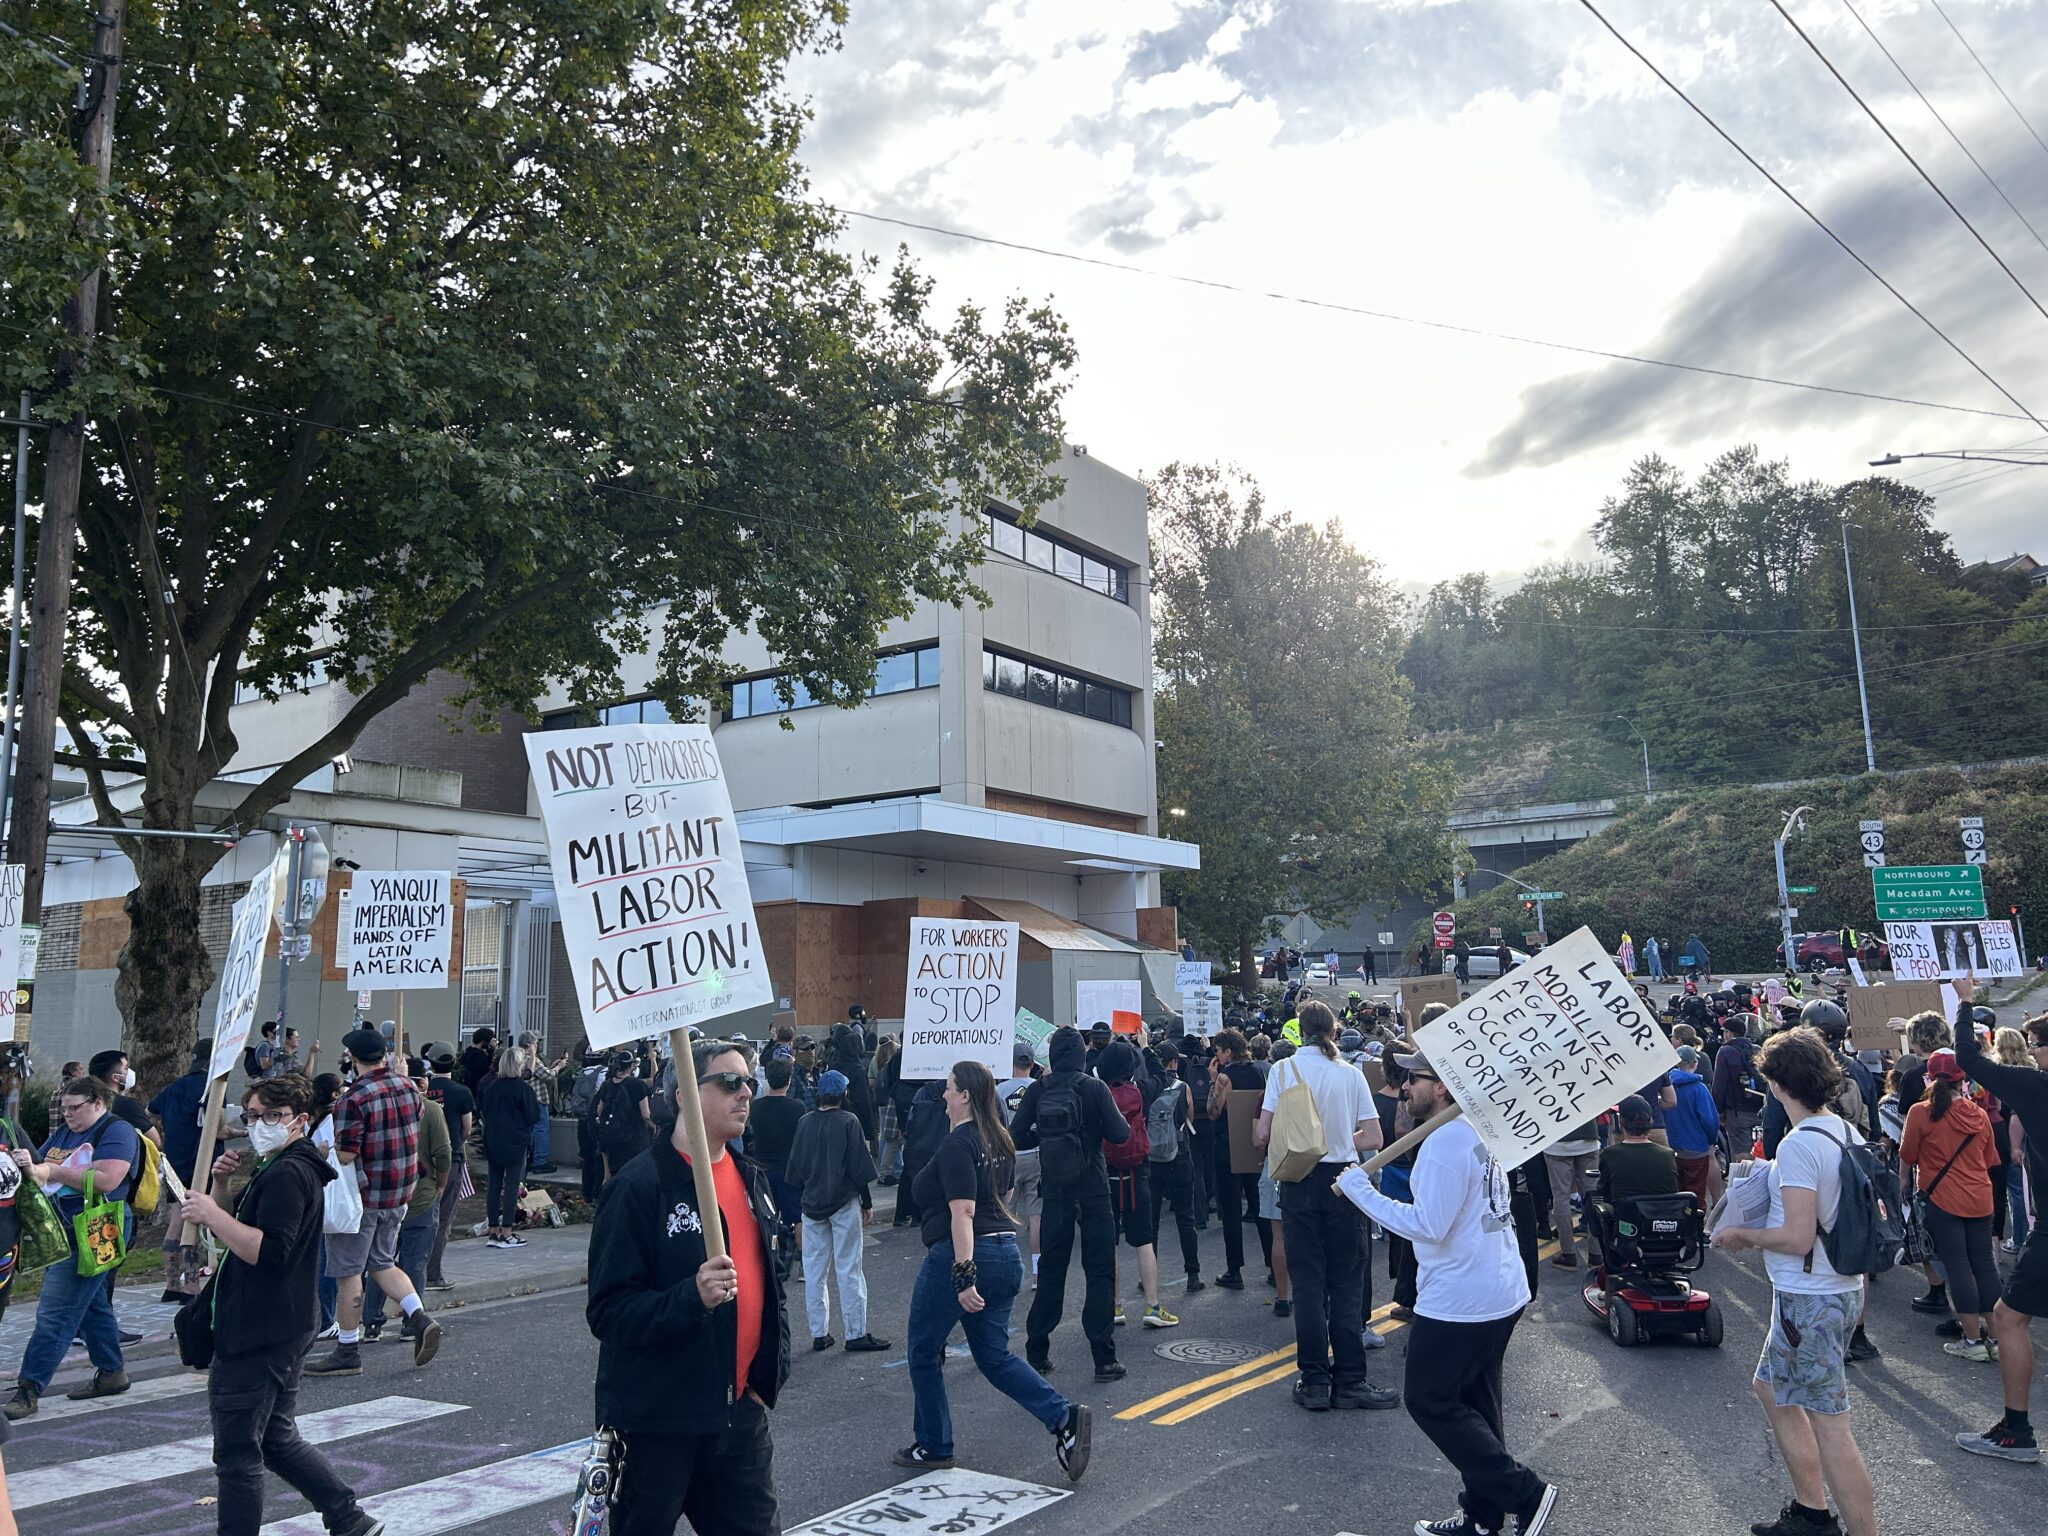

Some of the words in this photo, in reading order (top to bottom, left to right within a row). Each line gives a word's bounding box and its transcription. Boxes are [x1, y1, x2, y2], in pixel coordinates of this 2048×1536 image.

[545, 742, 614, 791] NOT
[624, 739, 719, 784] DEMOCRATS
[1861, 822, 1881, 830] SOUTH
[1864, 836, 1881, 847] 43
[1965, 832, 1982, 844] 43
[568, 817, 724, 884] MILITANT
[1884, 871, 1951, 879] NORTHBOUND
[370, 878, 438, 903] YANQUI
[1886, 889, 1942, 898] Macadam
[1948, 888, 1975, 896] Ave.
[591, 867, 722, 935] LABOR
[355, 904, 445, 928] IMPERIALISM
[353, 930, 395, 945] HANDS
[400, 928, 437, 942] OFF
[920, 927, 946, 947] FOR
[952, 928, 1008, 948] WORKERS
[1885, 924, 1922, 940] YOUR
[1979, 921, 2014, 935] EPSTEIN
[368, 944, 412, 958] LATIN
[1888, 943, 1913, 959] BOSS
[1916, 944, 1930, 959] IS
[1984, 937, 2011, 951] FILES
[353, 957, 444, 977] AMERICA
[591, 922, 750, 1012] ACTION!
[917, 951, 1005, 980] ACTION
[1179, 963, 1202, 974] Build
[1895, 960, 1907, 978] A
[1910, 959, 1941, 979] PEDO
[1989, 957, 2016, 976] NOW!
[1175, 975, 1209, 986] Community
[627, 1001, 708, 1032] INTERNATIONALIST
[710, 993, 733, 1010] GROUP
[913, 987, 928, 998] TO
[928, 984, 1001, 1025] STOP
[1578, 961, 1656, 1051] LABOR:
[1534, 965, 1627, 1071] MOBILIZE
[911, 1029, 1003, 1046] DEPORTATIONS!
[1447, 1021, 1465, 1036] OF
[1512, 979, 1614, 1087] AGAINST
[1489, 989, 1585, 1113] FEDERAL
[1467, 1006, 1570, 1123] OCCUPATION
[1435, 1057, 1486, 1119] INTERNATIONALIST
[1480, 1118, 1499, 1140] GROUP
[1451, 1039, 1547, 1150] PORTLAND!
